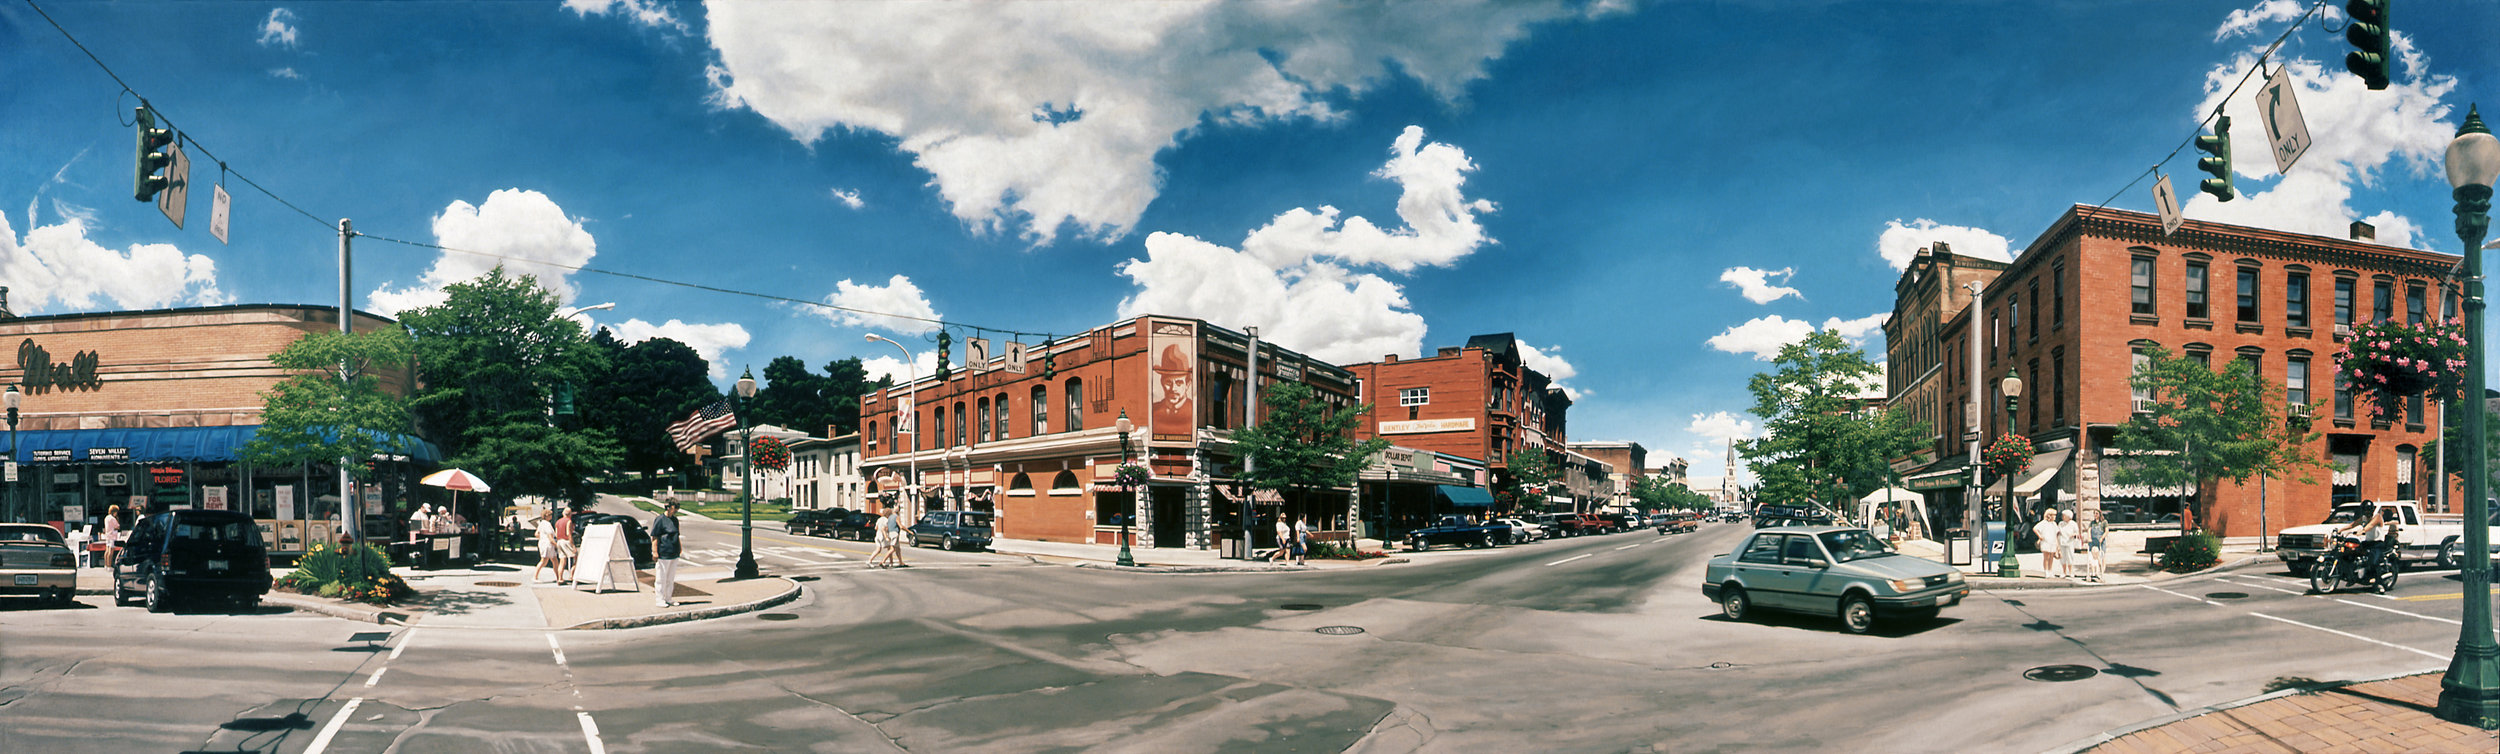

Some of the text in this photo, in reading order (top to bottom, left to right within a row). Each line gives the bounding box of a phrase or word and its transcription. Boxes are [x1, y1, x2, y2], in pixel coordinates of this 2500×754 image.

[2278, 132, 2300, 162] ONLY
[217, 191, 226, 204] NO
[2166, 216, 2178, 229] ONLY
[17, 337, 104, 396] Mall
[968, 361, 986, 369] ONLY
[1007, 363, 1023, 372] ONLY
[1383, 424, 1410, 432] BENTLEY
[1440, 420, 1469, 428] HARDWARE
[1385, 451, 1413, 463] DOLLAR DEPOT
[154, 475, 182, 483] FLORIST
